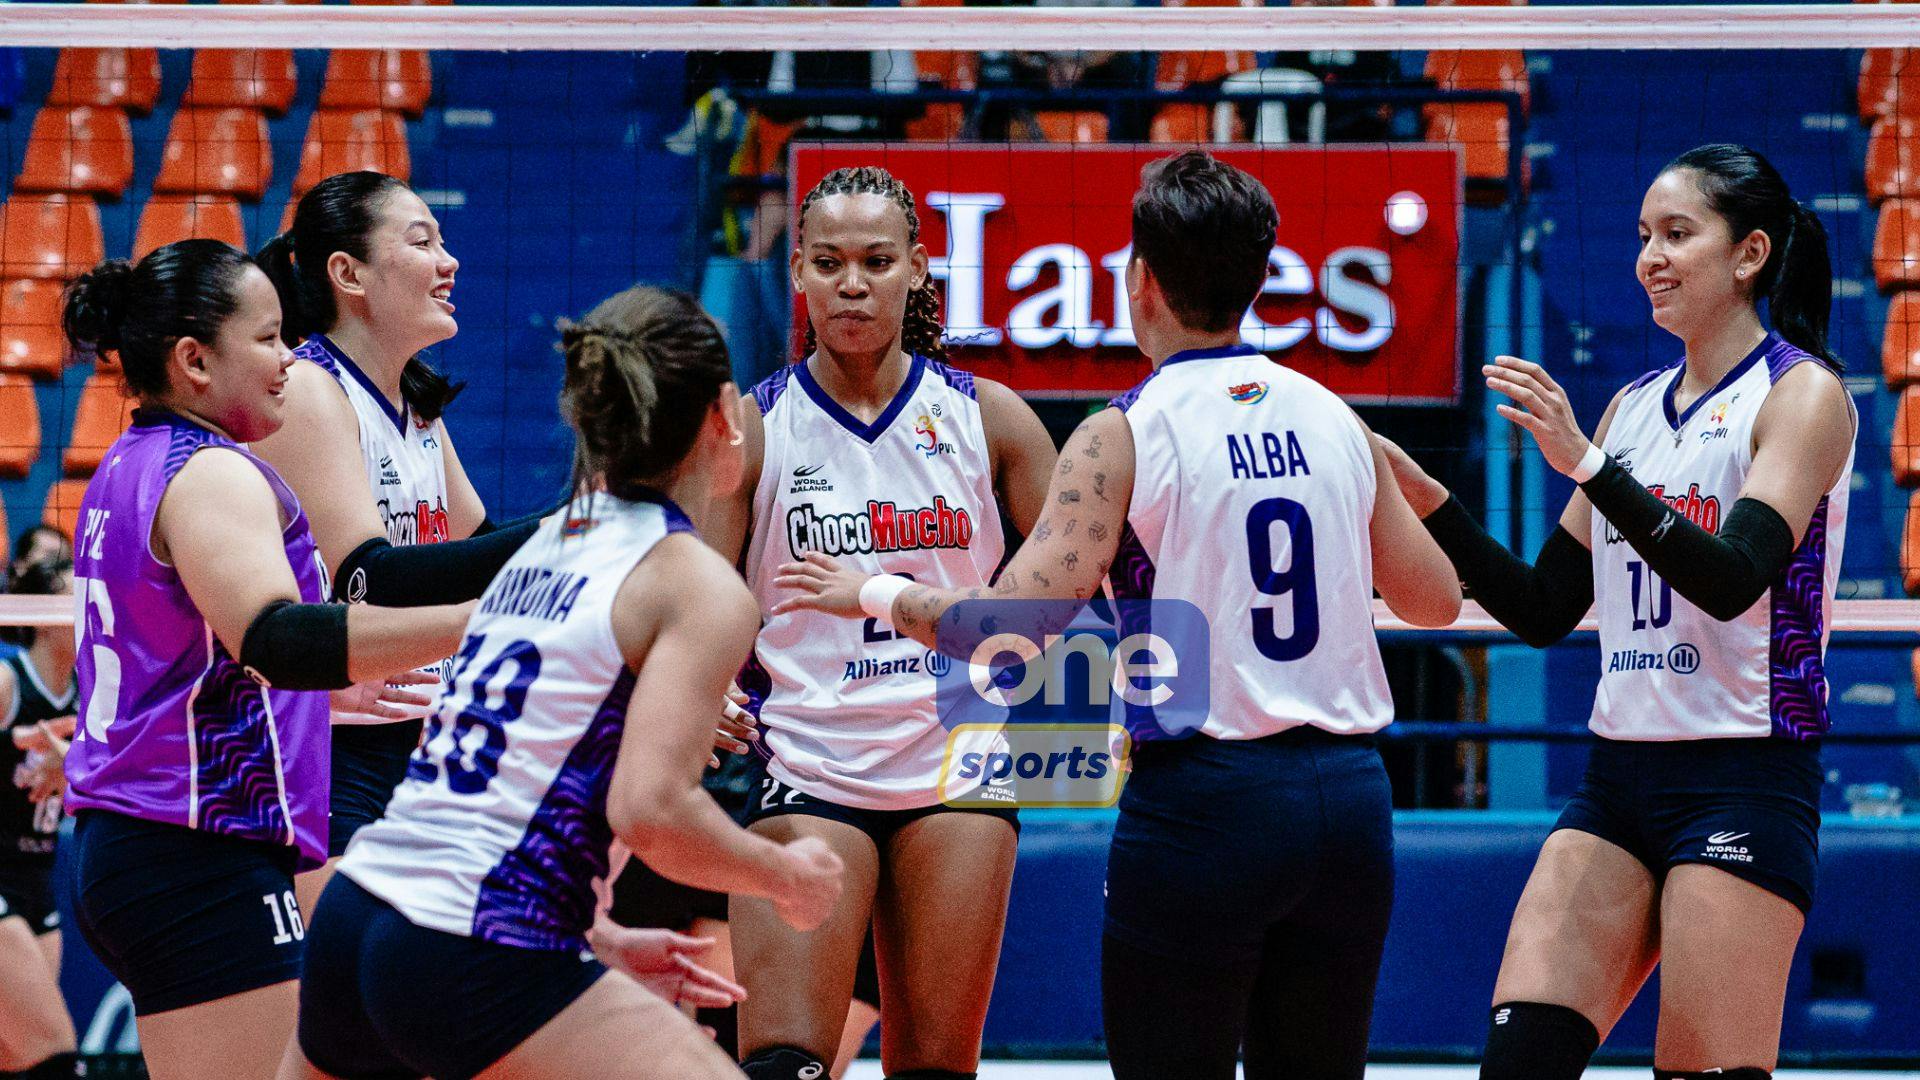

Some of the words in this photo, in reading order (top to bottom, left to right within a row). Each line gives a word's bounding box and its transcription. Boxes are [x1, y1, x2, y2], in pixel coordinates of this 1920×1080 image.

[938, 442, 956, 455] PVL
[1226, 430, 1311, 479] ALBA
[790, 485, 834, 494] BALANCE
[794, 478, 828, 486] WORLD
[787, 496, 973, 561] ChocoMucho
[1246, 497, 1320, 662] 9
[1626, 560, 1672, 631] 10
[842, 657, 920, 681] Allianz
[1608, 649, 1665, 673] Allianz
[761, 778, 805, 810] 22
[1706, 845, 1748, 854] WORLD
[262, 890, 305, 945] 16
